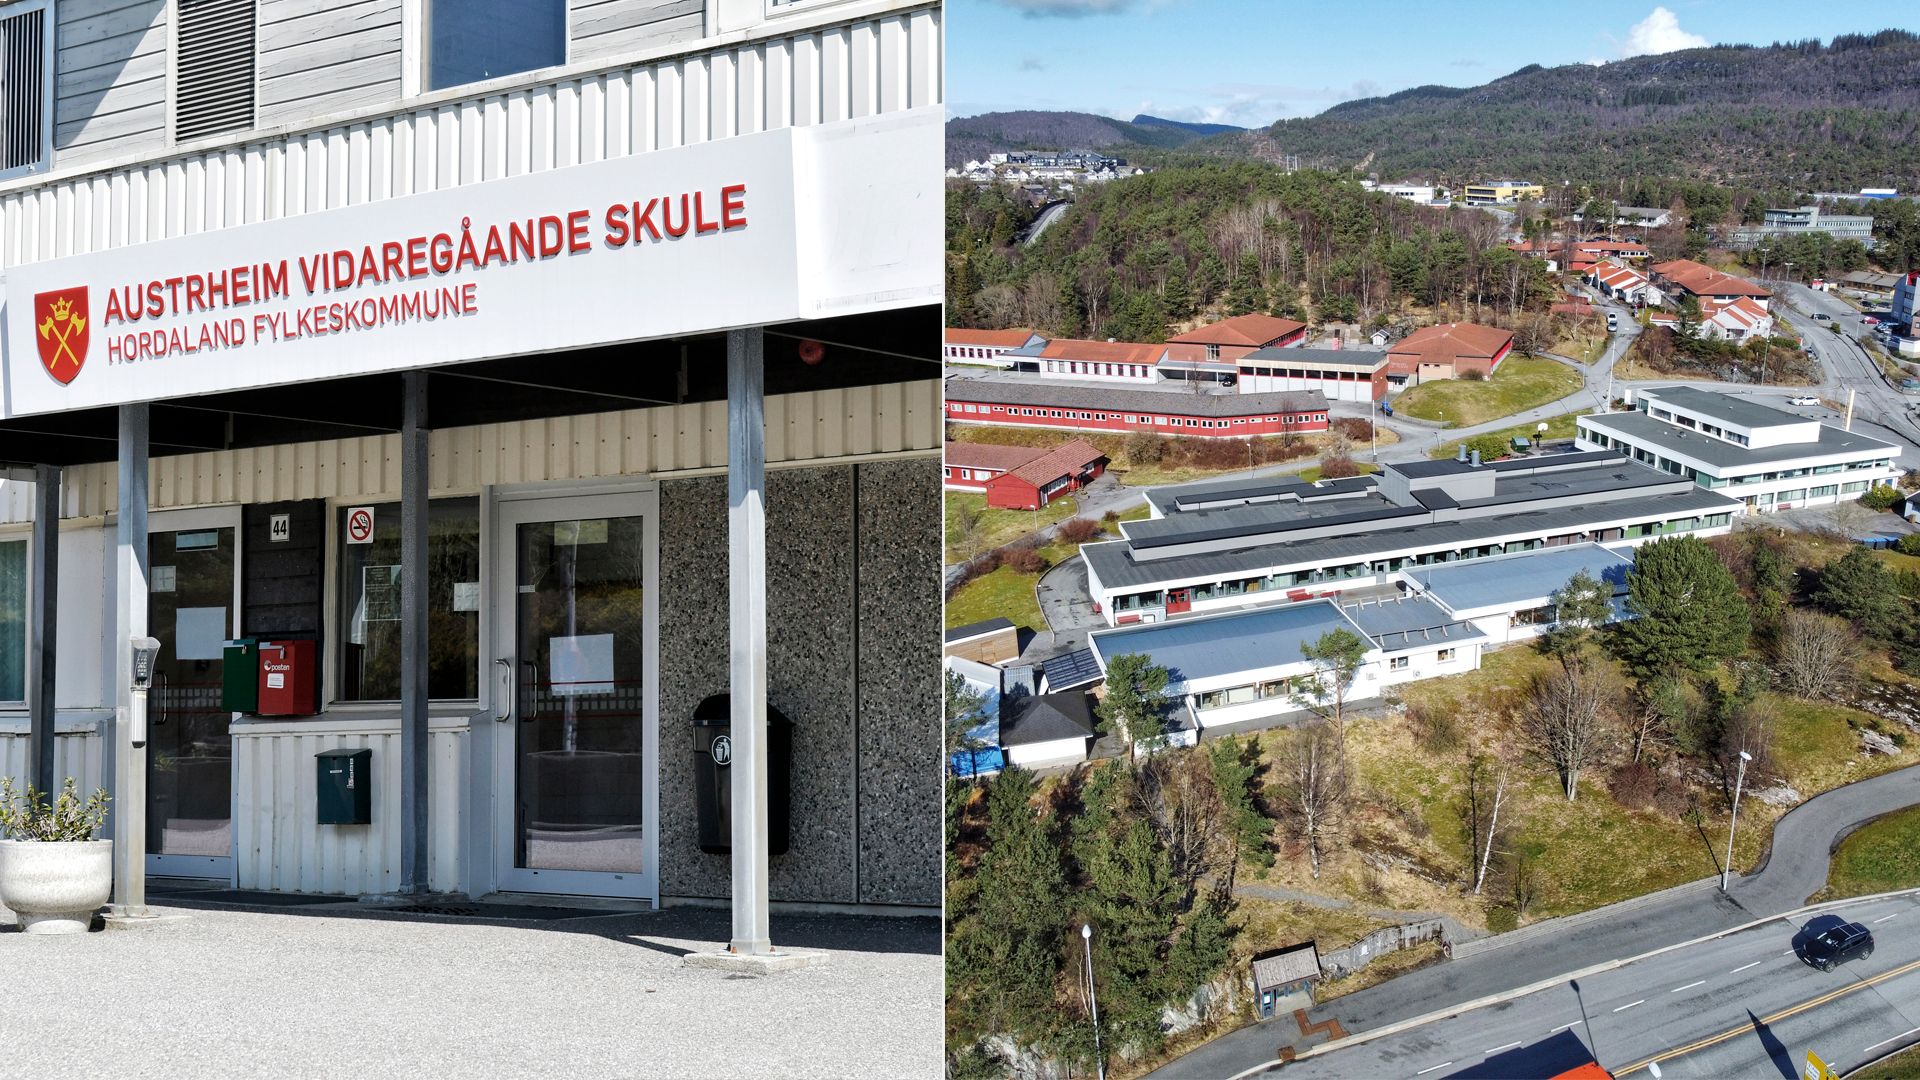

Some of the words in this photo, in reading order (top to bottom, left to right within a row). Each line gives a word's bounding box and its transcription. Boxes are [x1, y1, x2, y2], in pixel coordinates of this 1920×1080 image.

[104, 259, 290, 326] AUSTRHEIM
[299, 209, 592, 295] VIDAREGÅANDE
[605, 183, 748, 247] SKULE
[108, 317, 246, 363] HORDALAND
[253, 283, 478, 343] FYLKESKOMMUNE
[273, 519, 287, 536] 44
[271, 664, 290, 672] posten
